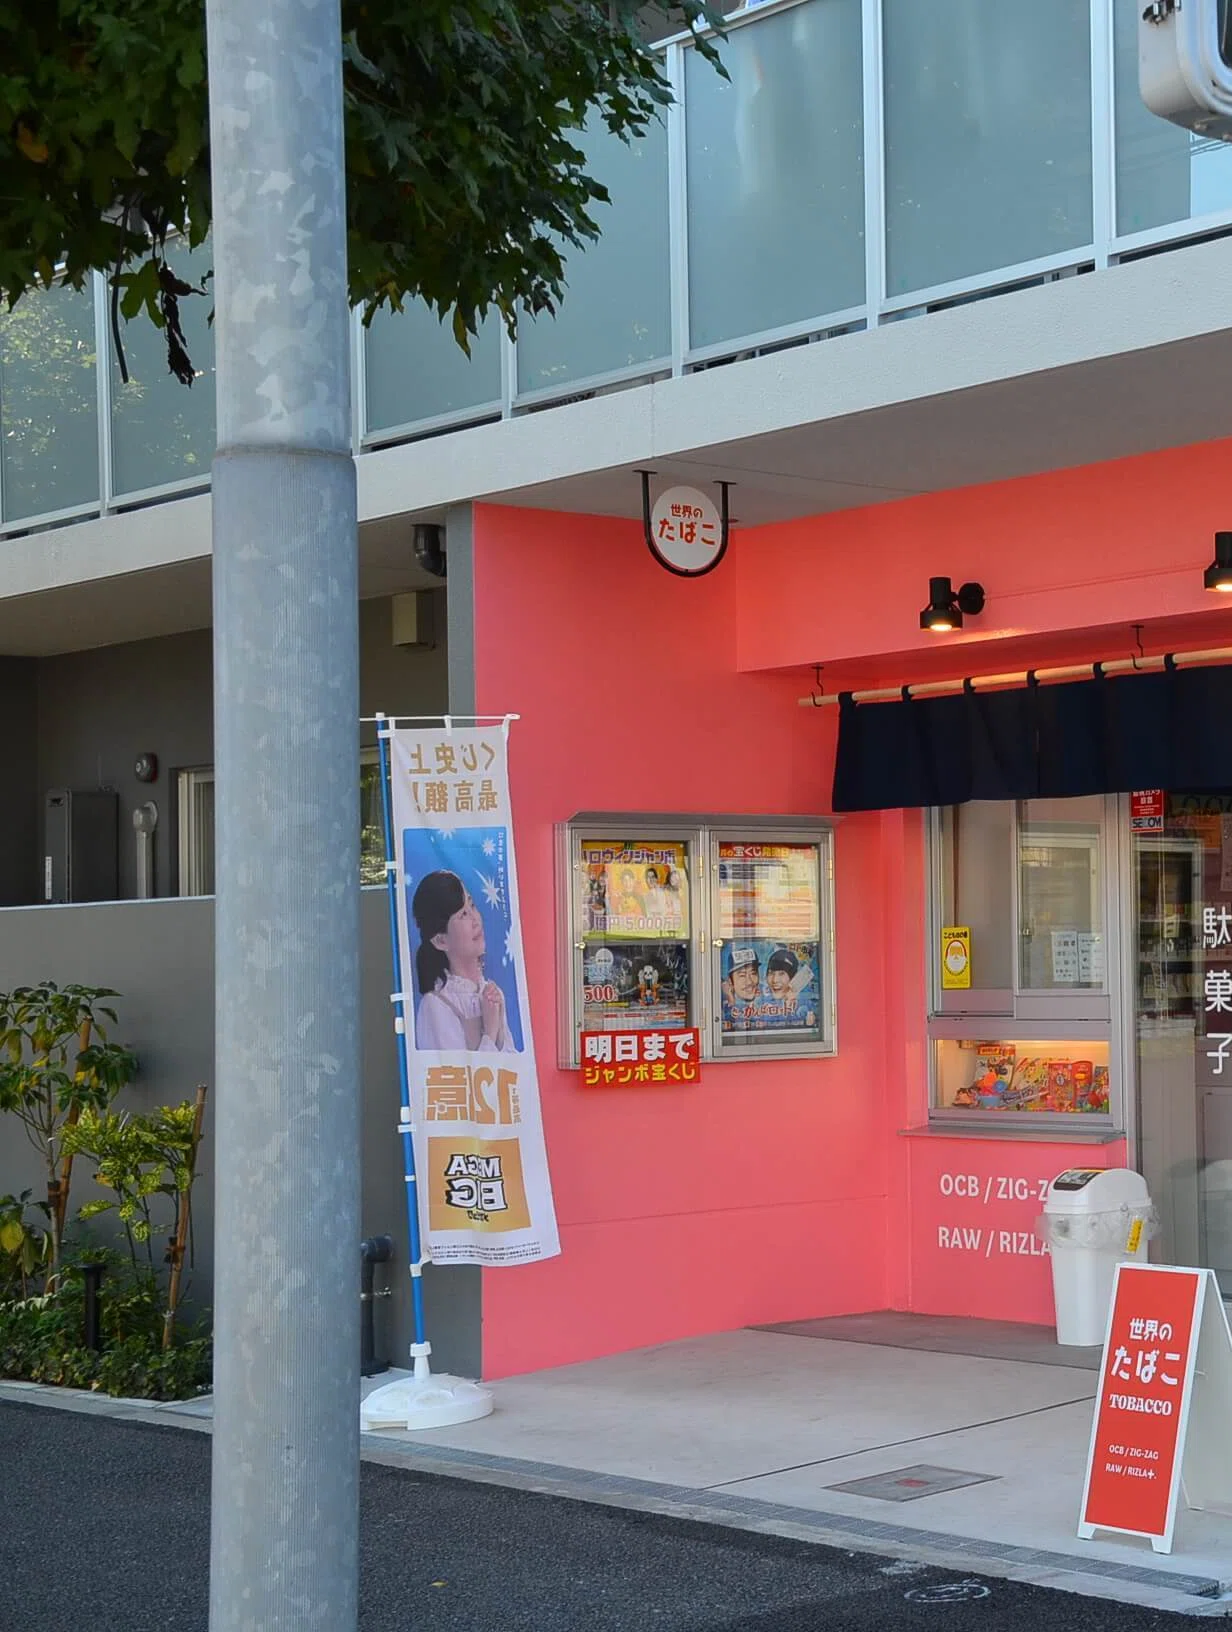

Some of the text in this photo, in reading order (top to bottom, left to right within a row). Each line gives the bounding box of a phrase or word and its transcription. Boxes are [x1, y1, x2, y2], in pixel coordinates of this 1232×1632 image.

[671, 504, 703, 518] 世界の
[659, 518, 715, 545] たばこ
[585, 1032, 695, 1062] 明日まで
[585, 1062, 696, 1084] ジャンボ宝くじ
[940, 1174, 979, 1196] OCB
[938, 1226, 982, 1250] RAW
[1129, 1318, 1173, 1341] 世界の
[1111, 1346, 1181, 1385] たばこ
[1109, 1393, 1172, 1416] TOBACCO
[1109, 1444, 1124, 1455] OCB
[1130, 1447, 1159, 1460] ZIG-ZAG
[1105, 1463, 1121, 1474] RAW
